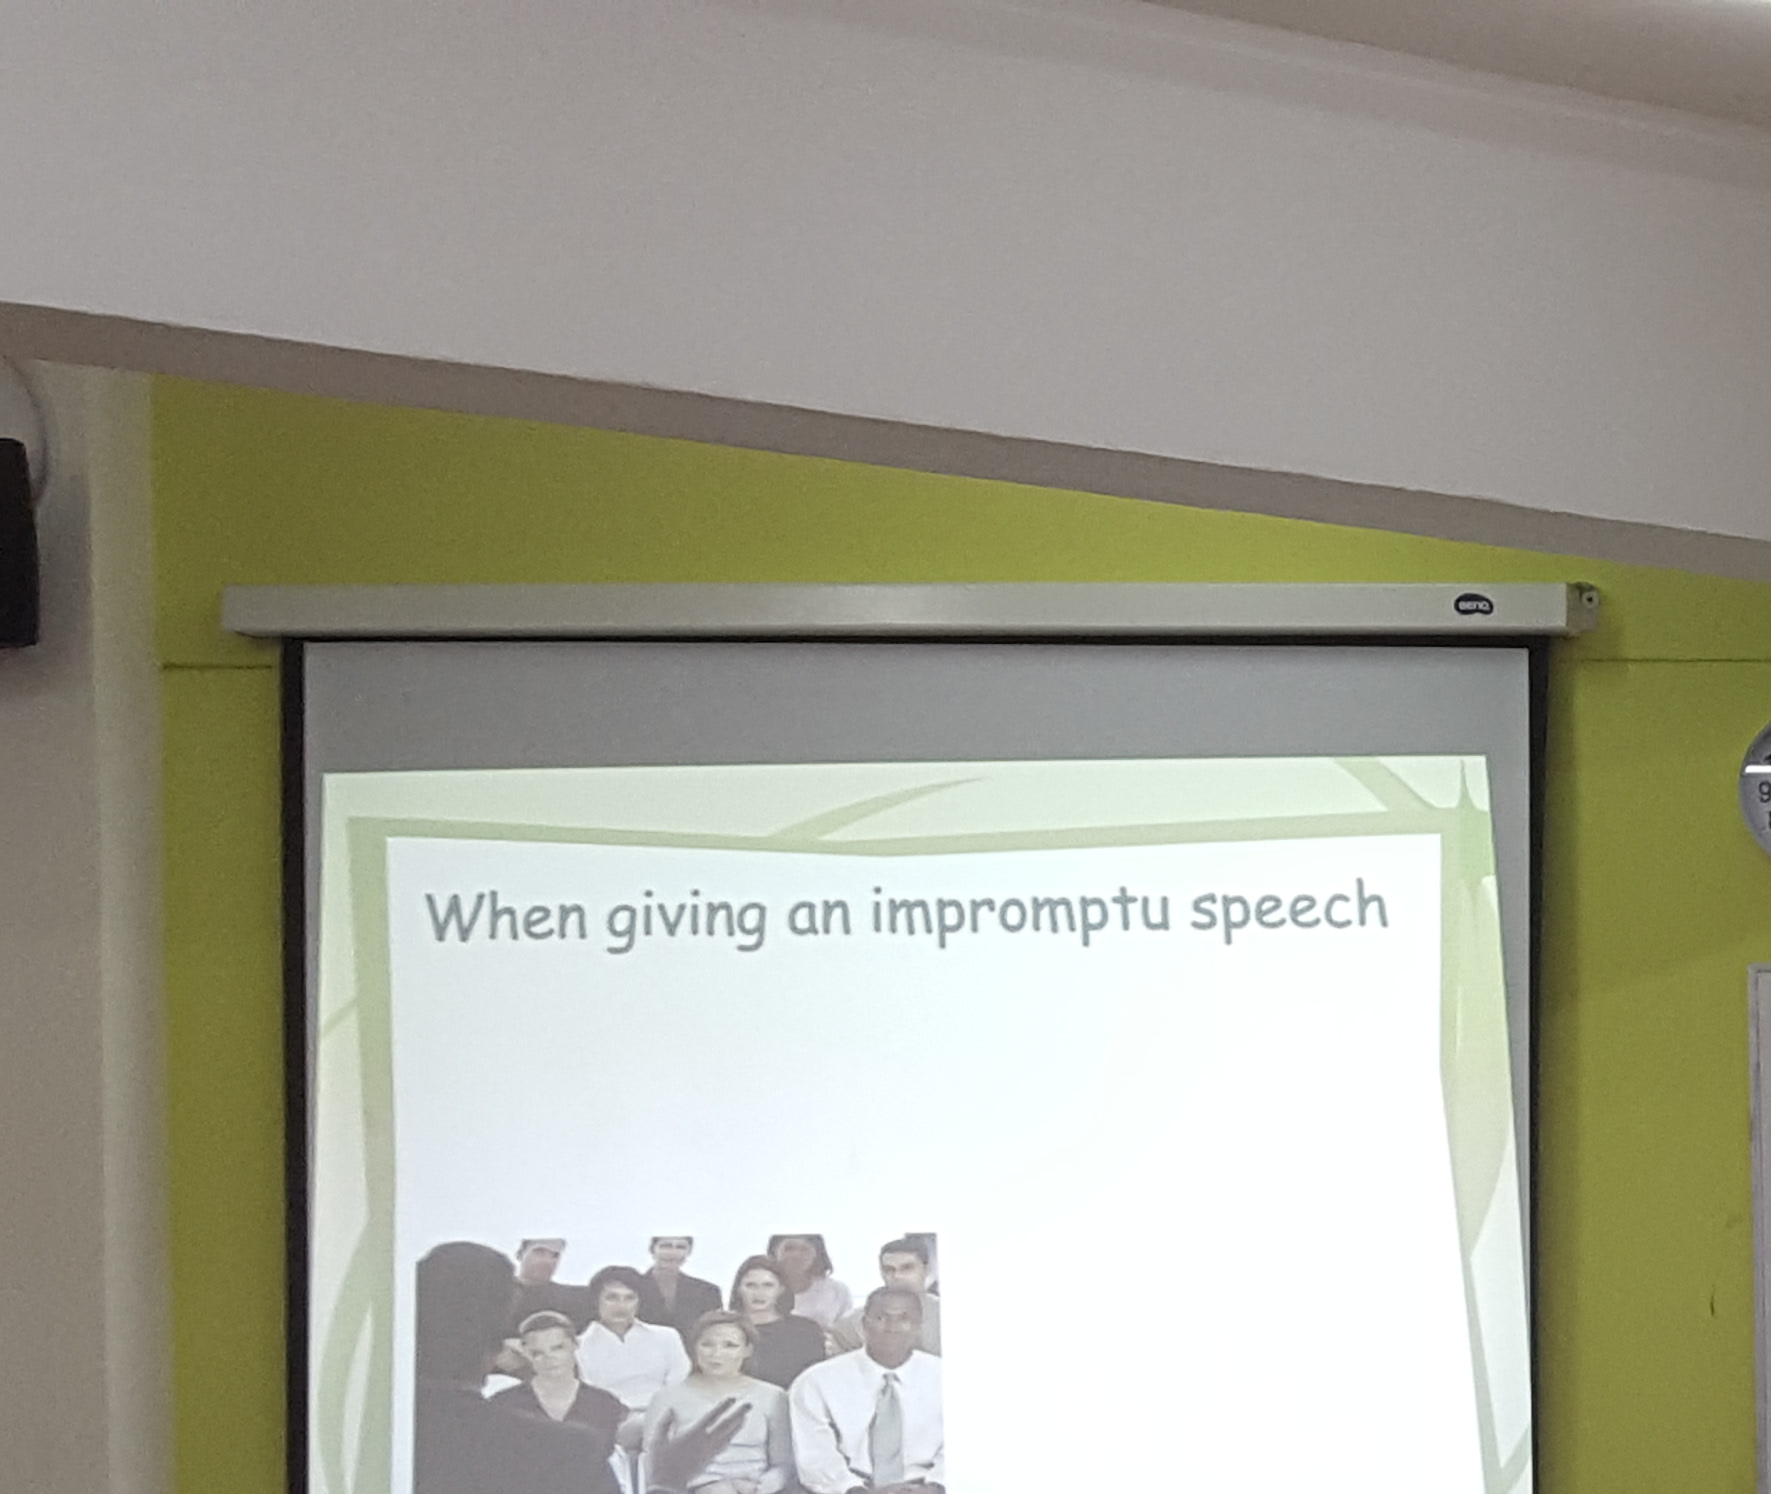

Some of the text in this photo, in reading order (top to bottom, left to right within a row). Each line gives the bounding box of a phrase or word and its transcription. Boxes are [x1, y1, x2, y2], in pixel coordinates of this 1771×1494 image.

[425, 877, 1389, 954] When giving an impromptu speech
